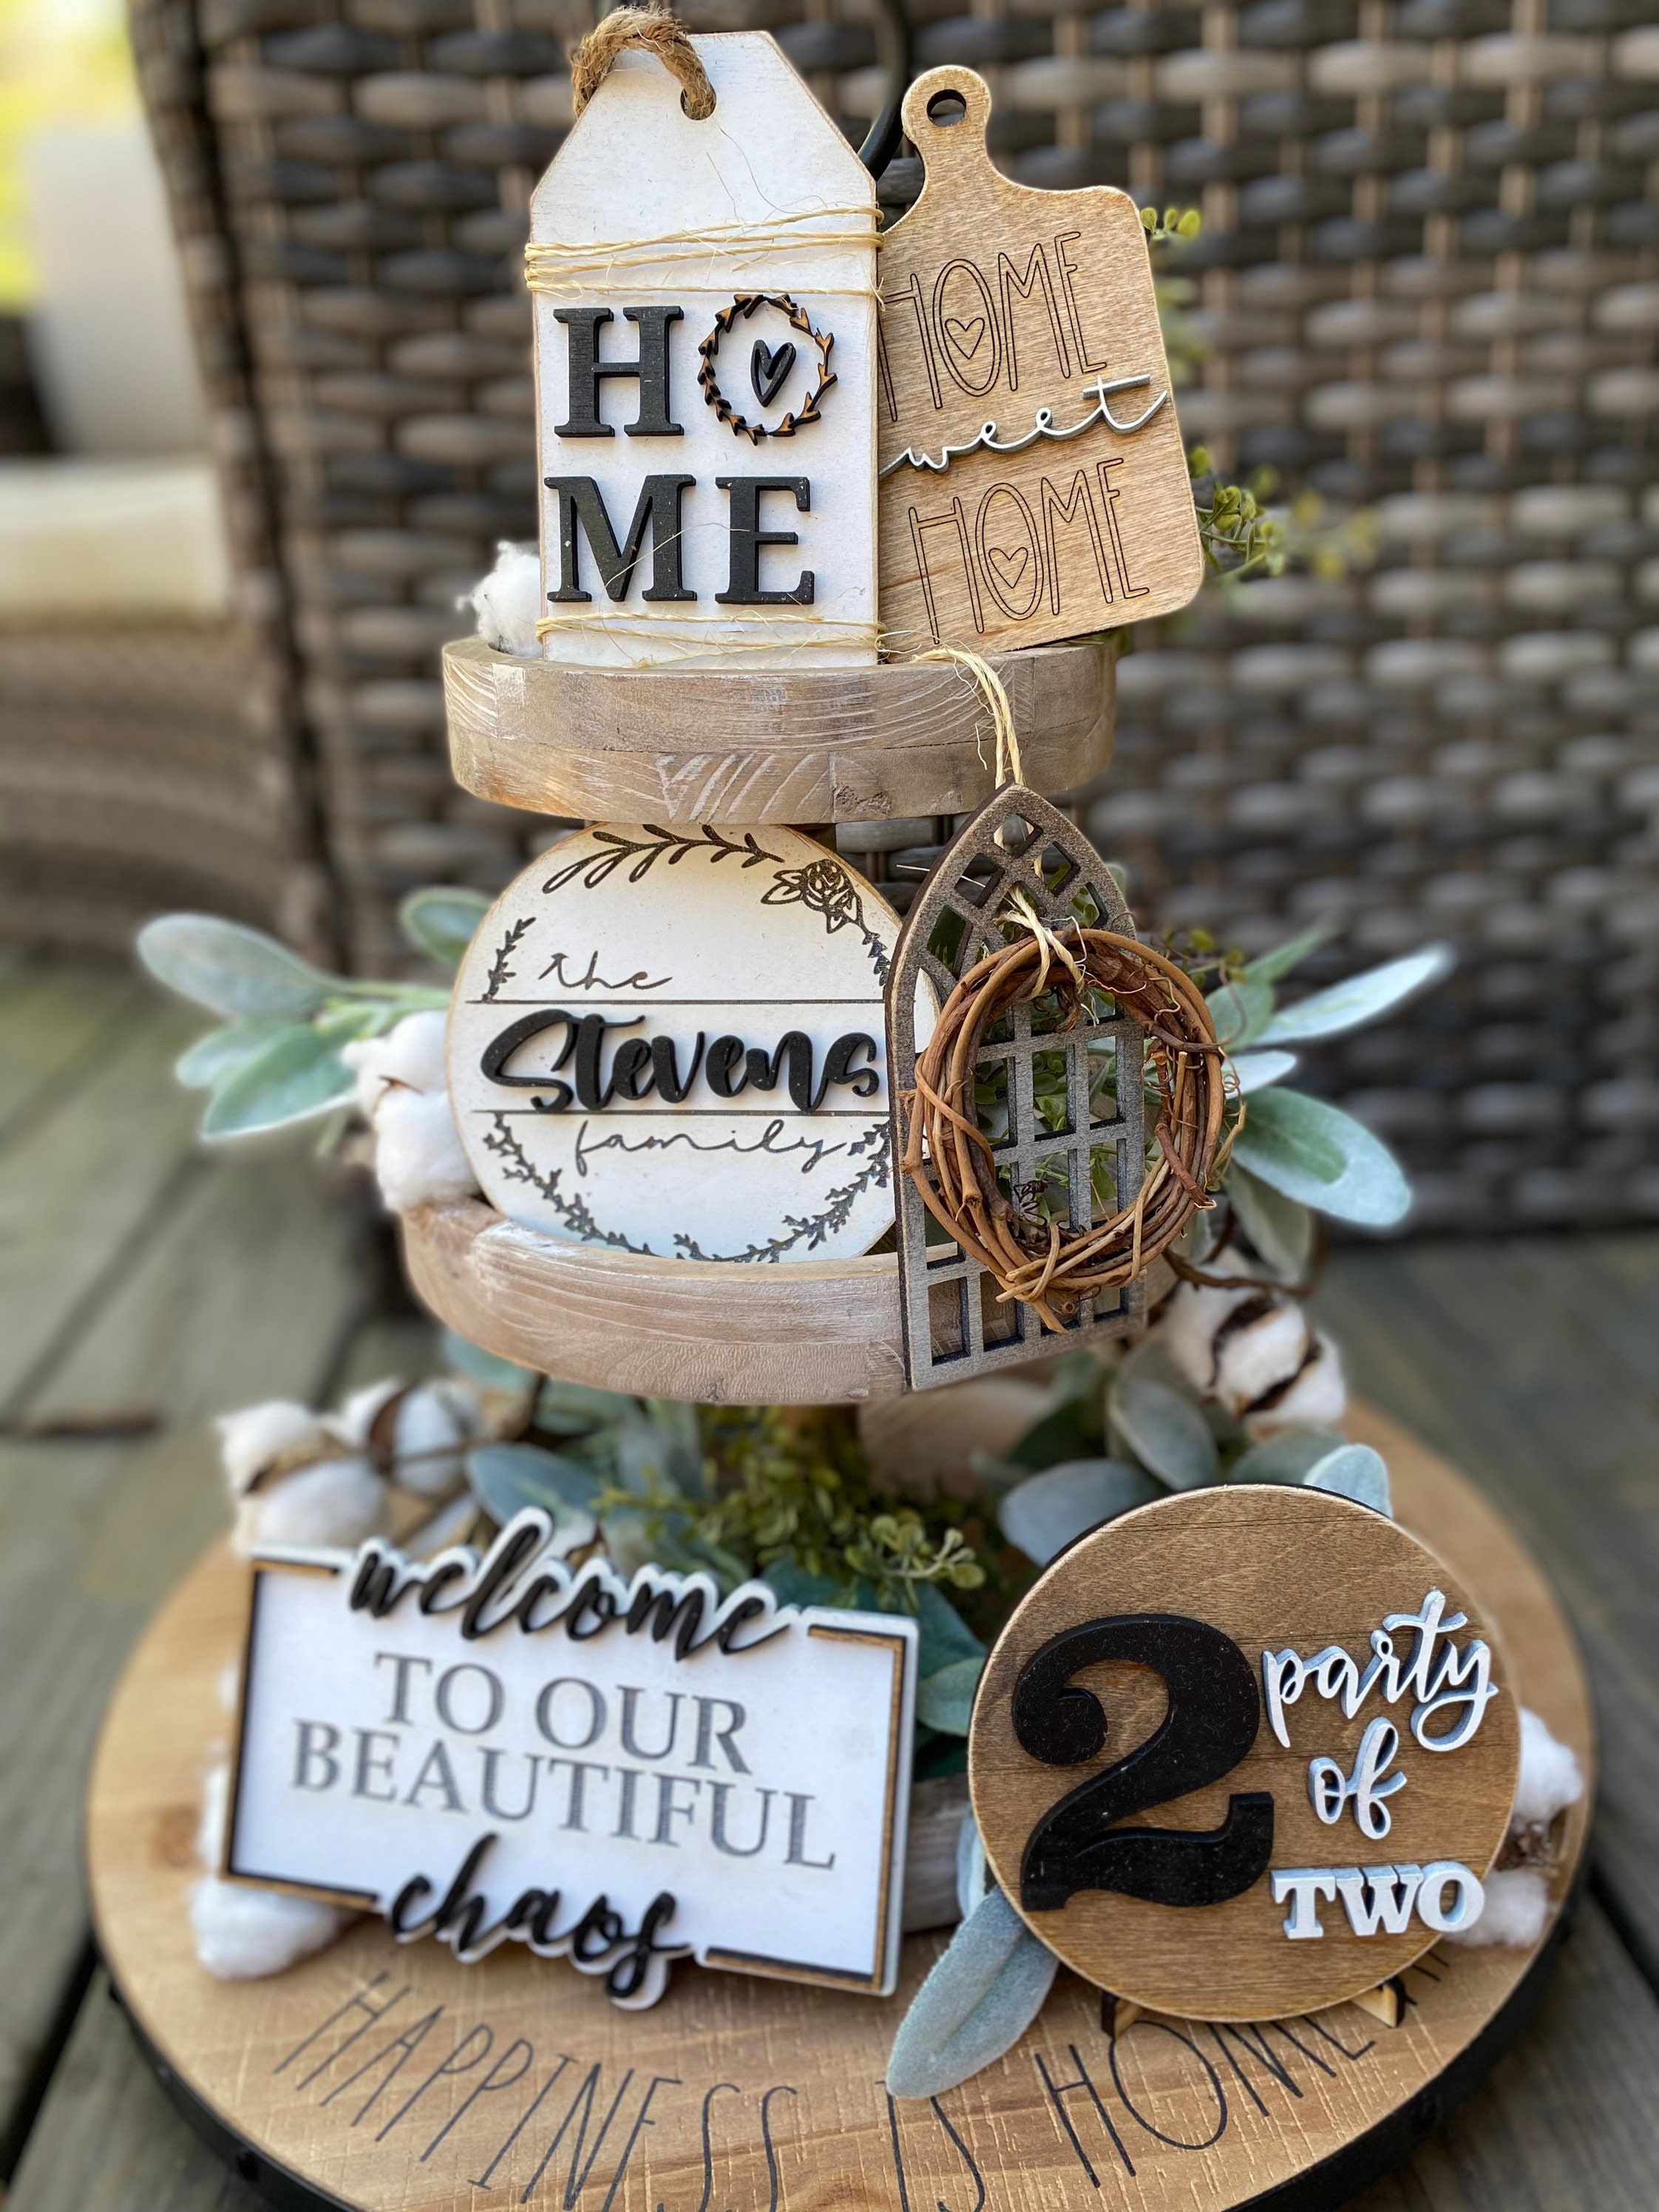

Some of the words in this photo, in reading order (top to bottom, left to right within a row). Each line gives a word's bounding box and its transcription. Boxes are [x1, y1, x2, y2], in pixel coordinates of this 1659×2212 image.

[878, 374, 1168, 481] weet
[544, 474, 814, 604] ME
[909, 458, 1150, 644] HOME
[537, 950, 673, 991] the
[481, 1008, 880, 1112] Stevens
[575, 1119, 847, 1178] family
[349, 1520, 792, 1662] welcome
[373, 1650, 505, 1736] TO
[535, 1675, 753, 1774] OUR
[1261, 1586, 1499, 1752] party
[290, 1719, 837, 1870] BEAUTIFUL
[1011, 1612, 1275, 1912] 2
[1309, 1716, 1407, 1839] of
[389, 1831, 693, 1999] chaos
[1270, 1860, 1485, 1939] TWO
